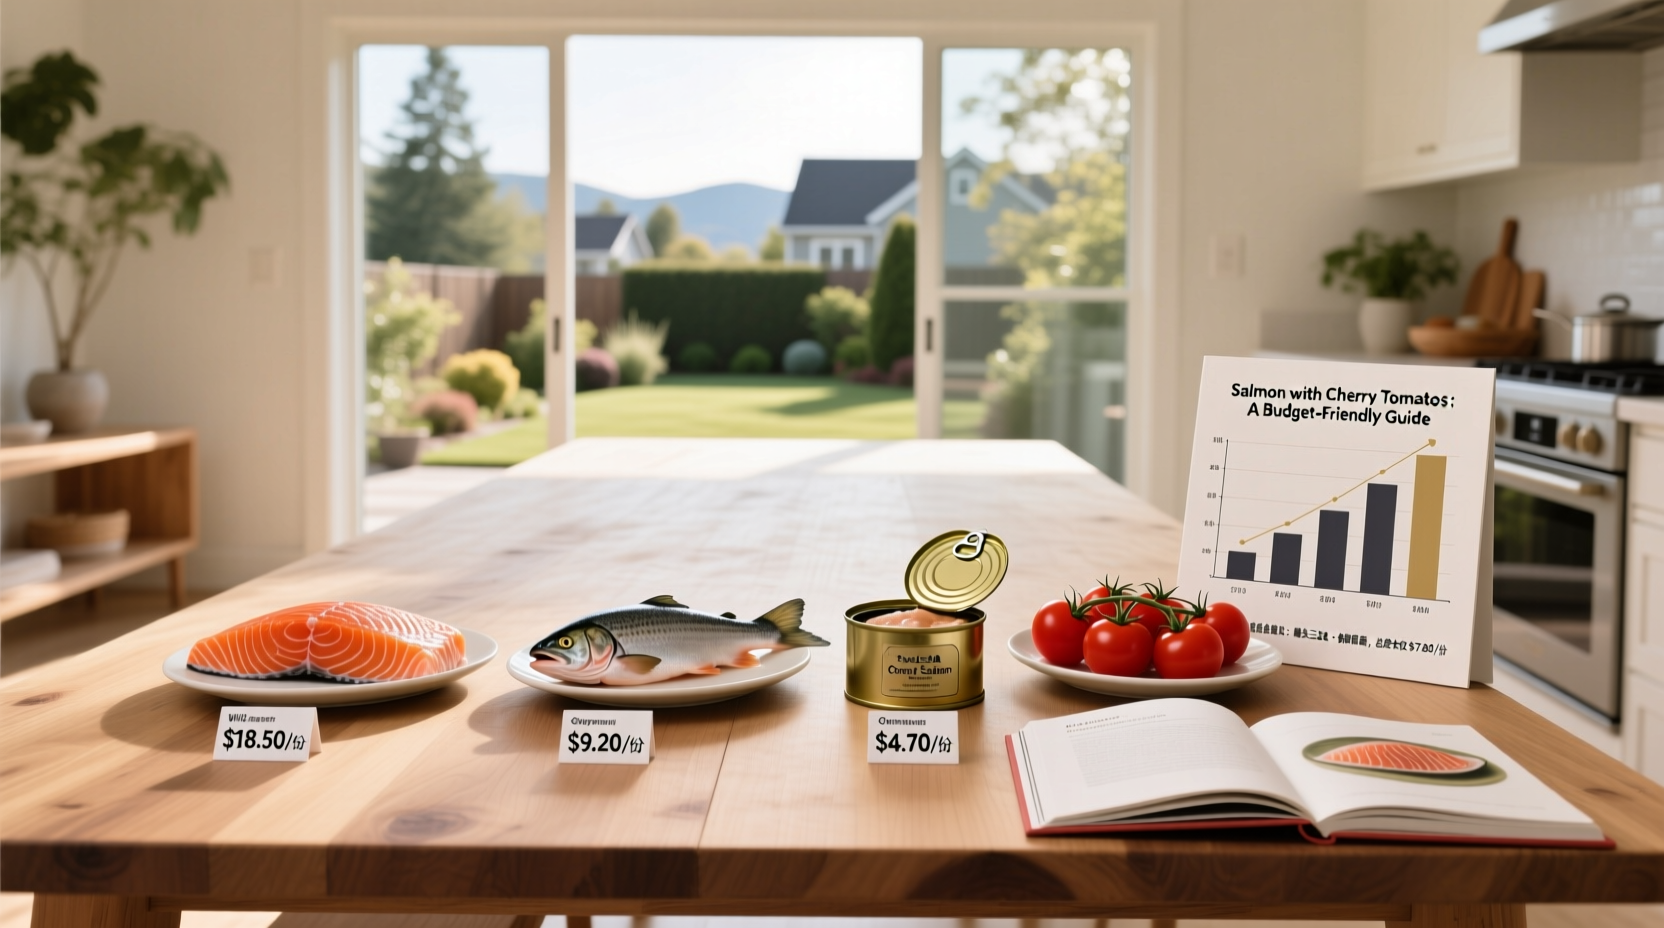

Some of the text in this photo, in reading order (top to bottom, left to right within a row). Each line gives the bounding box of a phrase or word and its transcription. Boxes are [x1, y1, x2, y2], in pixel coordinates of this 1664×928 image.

[1231, 383, 1286, 399] Salmon
[1290, 386, 1322, 401] with
[1326, 387, 1377, 405] Cherry
[1247, 402, 1431, 426] A Budget-Friendly Guide
